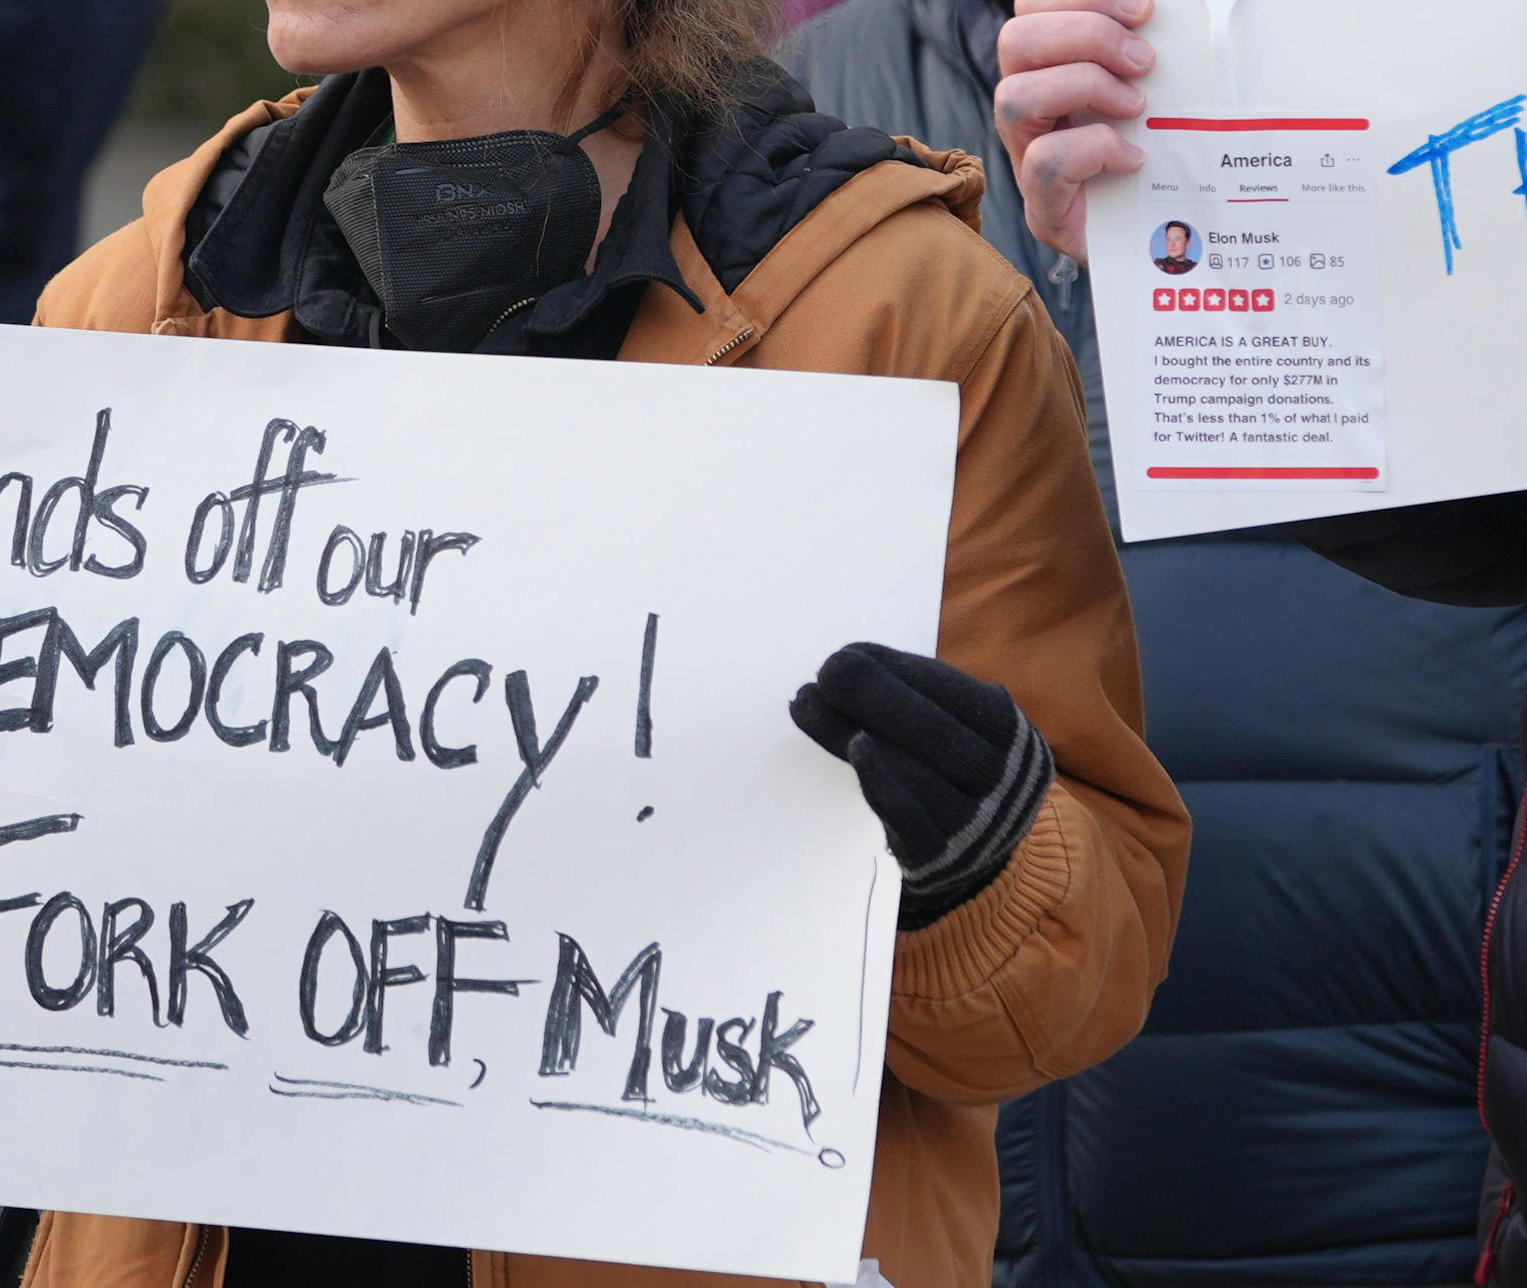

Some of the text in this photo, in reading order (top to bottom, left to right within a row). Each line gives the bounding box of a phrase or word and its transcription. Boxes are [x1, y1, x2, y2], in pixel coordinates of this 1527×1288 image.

[1219, 152, 1293, 168] America
[1151, 182, 1179, 192] Menu
[1199, 183, 1217, 193] Info
[1238, 183, 1280, 193] Reviews
[1301, 183, 1366, 193] More like this
[1207, 231, 1281, 245] Elon Musk
[1226, 255, 1346, 269] 117 106 85
[1283, 292, 1355, 309] 2 days ago
[1154, 336, 1334, 348] AMERICA IS A GREAT BUY.
[1162, 355, 1209, 369] bought
[1211, 355, 1233, 367] the
[1235, 355, 1274, 367] entire
[1276, 355, 1324, 370] country
[1326, 355, 1352, 367] and
[1354, 355, 1371, 367] its
[1153, 373, 1339, 388] democracy for only $277M in
[1154, 392, 1335, 407] Trump campaign donations.
[1153, 411, 1195, 424] That's
[1197, 411, 1225, 424] less
[1228, 412, 1258, 424] than
[1260, 412, 1282, 424] 1%
[1284, 412, 1297, 424] of
[1300, 412, 1332, 424] what
[1340, 411, 1370, 427] paid
[1153, 430, 1334, 444] for Twitter! A fantastic deal.
[184, 417, 359, 594] off
[316, 524, 481, 616] our
